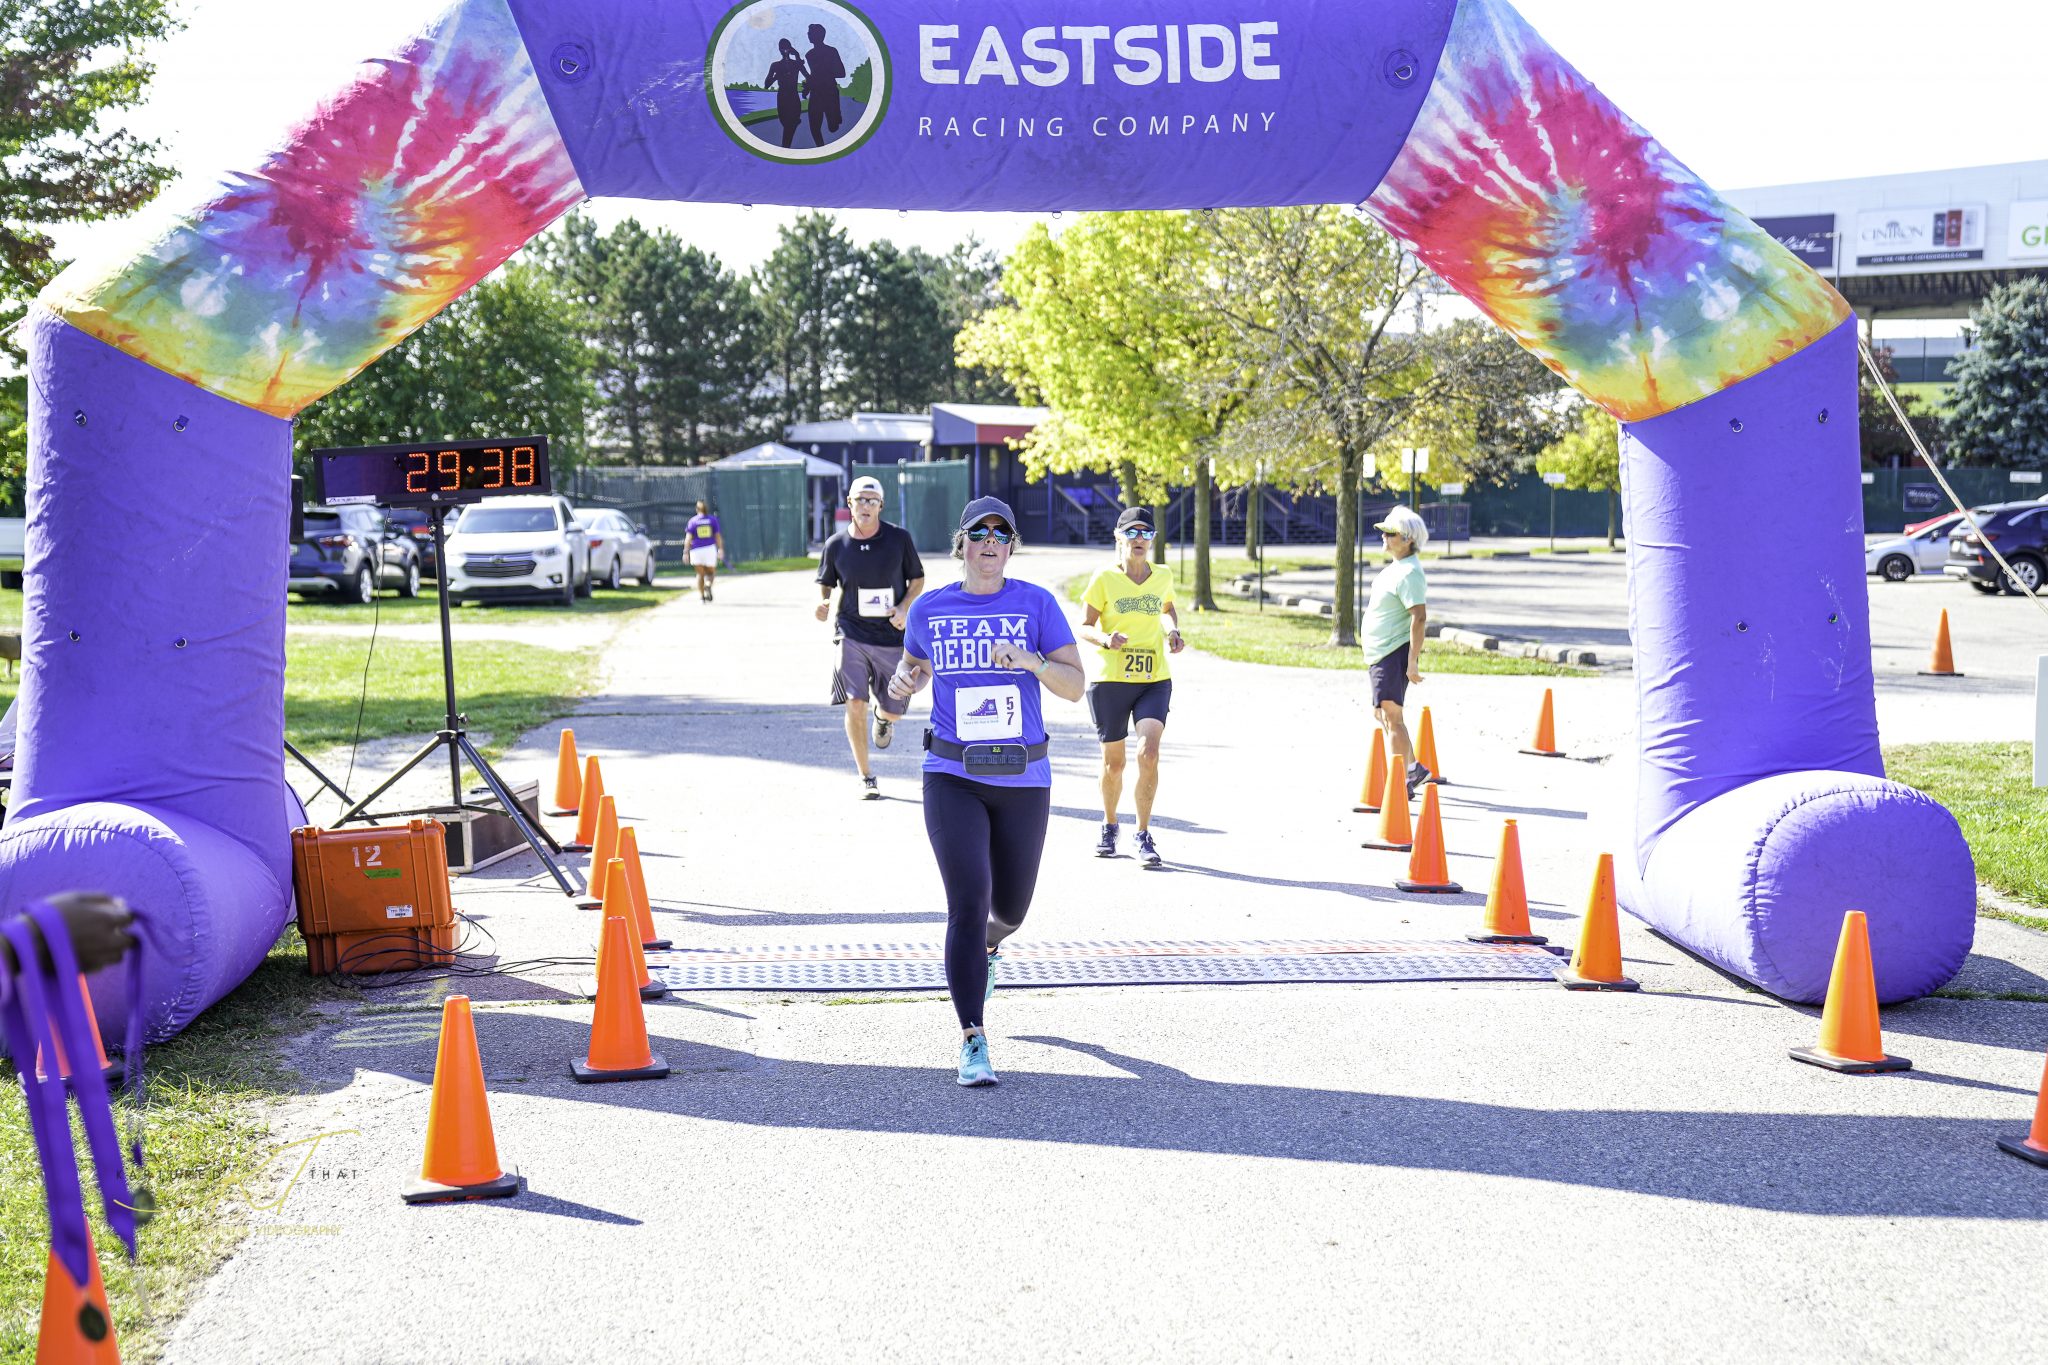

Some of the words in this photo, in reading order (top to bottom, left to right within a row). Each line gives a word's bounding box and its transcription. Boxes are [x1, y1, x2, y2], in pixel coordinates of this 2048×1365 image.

[919, 21, 1280, 87] EASTSIDE
[918, 116, 1064, 138] RACING
[1092, 112, 1276, 137] COMPANY
[928, 618, 1027, 639] TEAM
[1125, 654, 1153, 673] 250
[352, 845, 382, 867] 12
